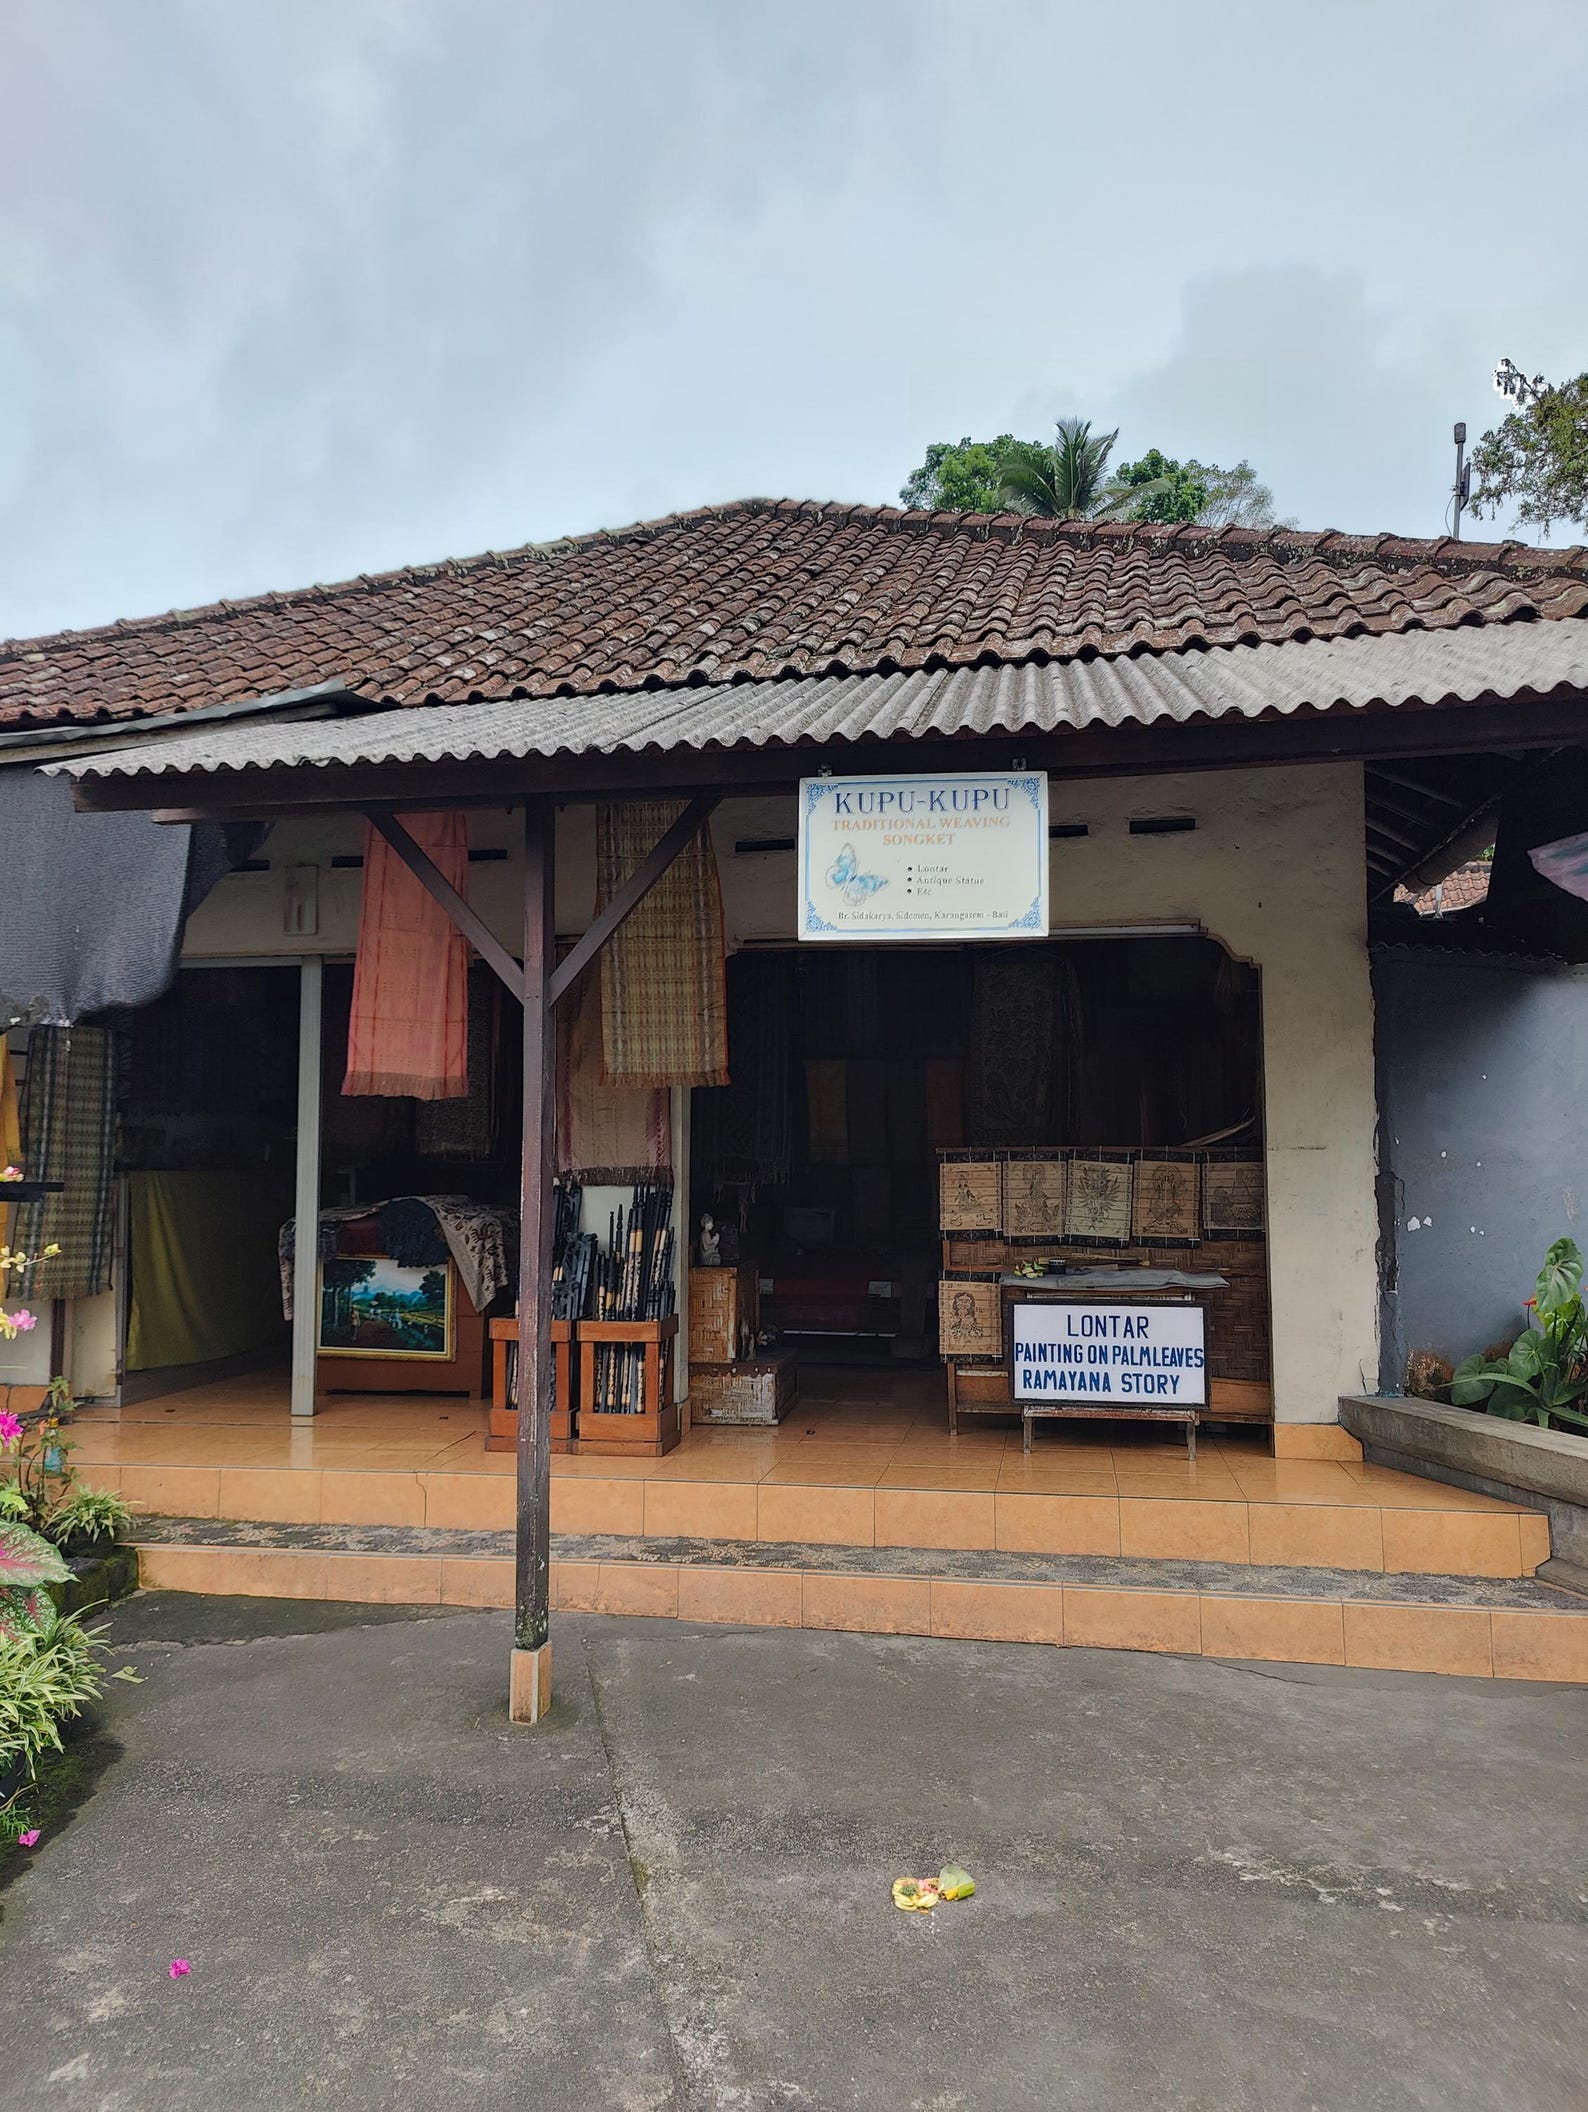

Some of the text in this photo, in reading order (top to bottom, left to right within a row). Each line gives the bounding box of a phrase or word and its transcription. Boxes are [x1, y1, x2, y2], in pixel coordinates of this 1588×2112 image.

[835, 788, 1010, 814] KUPU-KUPU
[832, 816, 1010, 831] TRADITIONAL WEAVING
[883, 833, 956, 846] SONGKET
[1067, 1314, 1149, 1339] LONTAR
[1015, 1342, 1083, 1364] PAINTING
[1087, 1344, 1108, 1365] ON
[1022, 1369, 1180, 1395] RAMAYANA STORY
